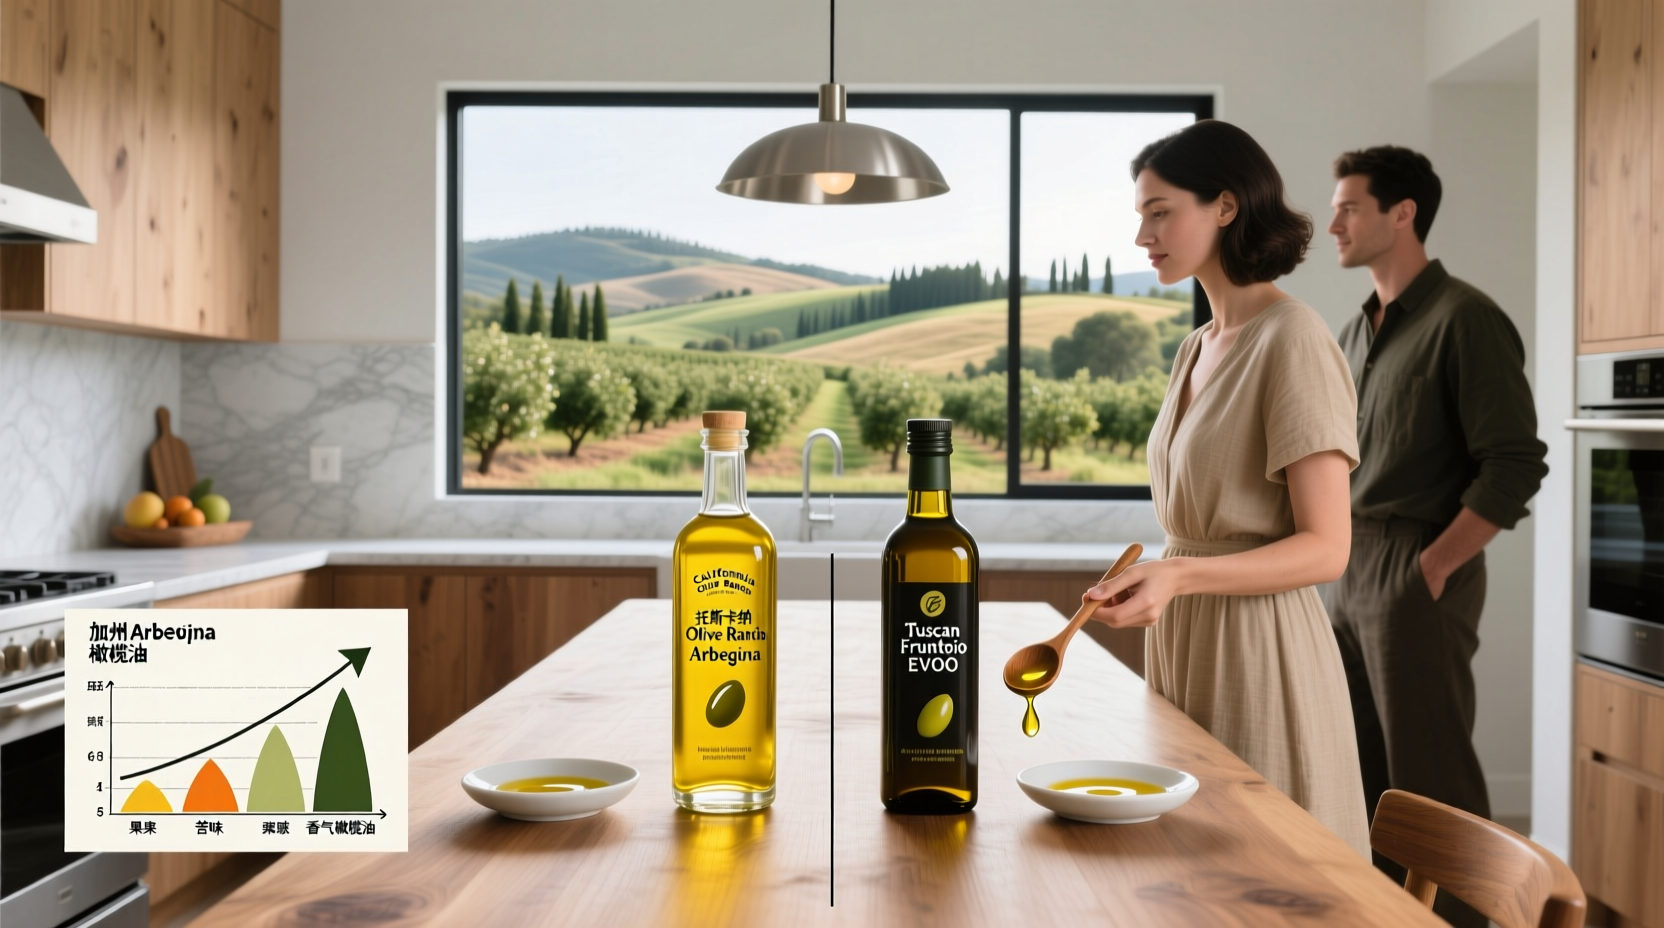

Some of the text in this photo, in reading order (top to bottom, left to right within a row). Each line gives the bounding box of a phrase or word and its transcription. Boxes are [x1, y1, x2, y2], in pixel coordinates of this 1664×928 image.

[685, 626, 723, 641] Olive
[904, 622, 960, 638] Tuscan
[689, 646, 761, 667] Arbegina
[908, 656, 959, 672] EVOO
